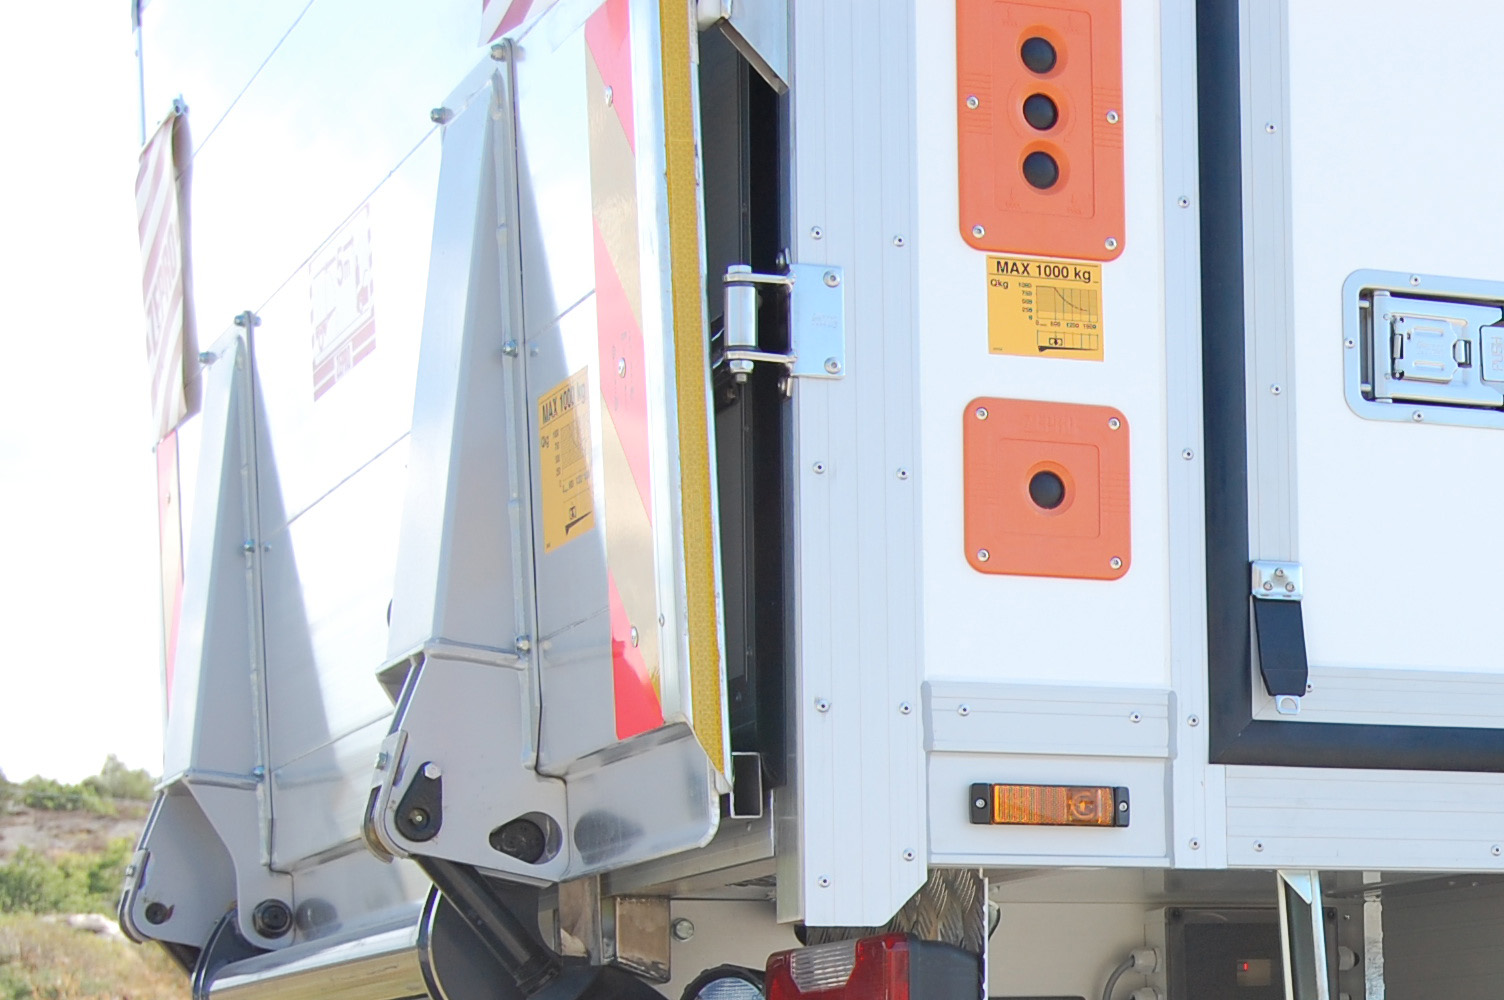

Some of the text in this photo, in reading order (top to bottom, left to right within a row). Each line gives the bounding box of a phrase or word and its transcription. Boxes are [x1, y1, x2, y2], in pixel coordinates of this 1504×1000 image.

[990, 279, 1009, 289] Qkg
[996, 260, 1091, 284] MAX 1000 kg
[542, 396, 558, 424] MAX
[559, 386, 575, 413] 1000
